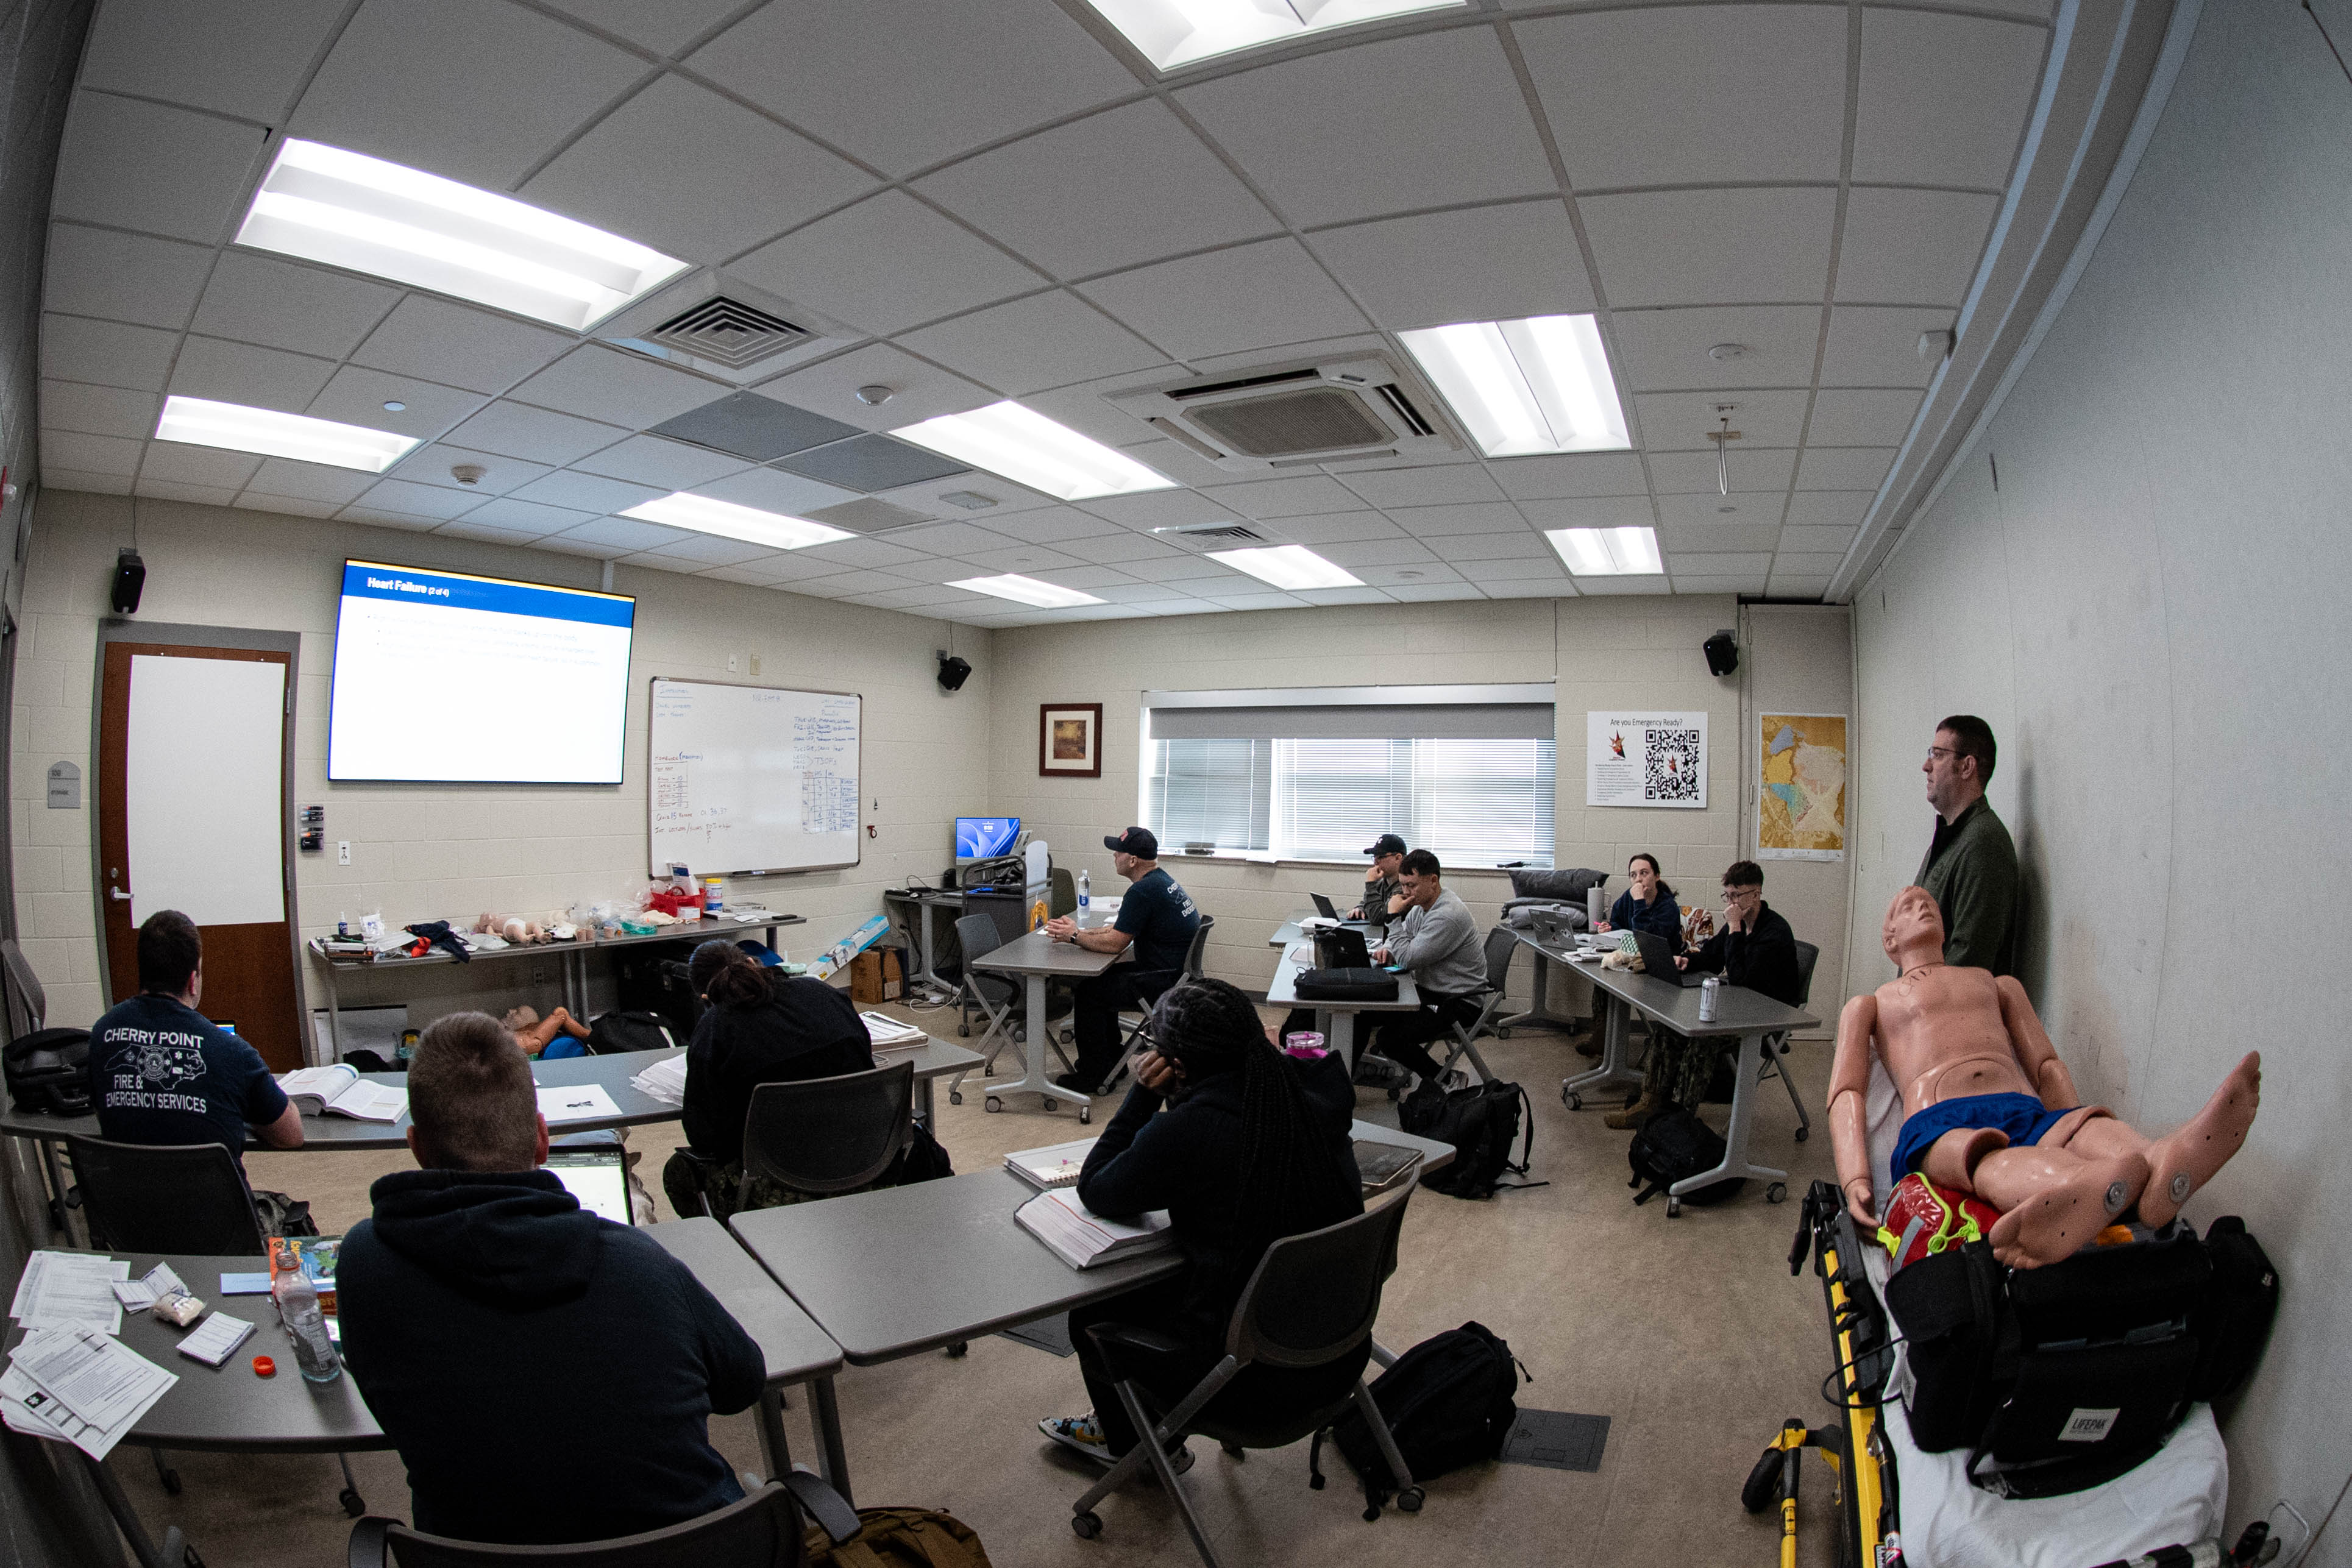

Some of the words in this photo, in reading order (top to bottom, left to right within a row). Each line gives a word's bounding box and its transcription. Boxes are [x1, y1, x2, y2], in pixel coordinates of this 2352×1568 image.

[368, 577, 394, 590] Heart
[394, 580, 427, 594] Failure
[428, 587, 435, 595] (2
[442, 589, 450, 598] 4)
[1632, 718, 1662, 728] Emergency
[1663, 718, 1683, 727] Ready?
[104, 1027, 156, 1045] CHERRY
[158, 1032, 204, 1049] POINT
[114, 1074, 134, 1089] FIRE
[135, 1074, 144, 1090] &
[106, 1091, 156, 1108] EMERGENCY
[157, 1093, 207, 1113] SERVICES
[2072, 1418, 2108, 1430] LIFEPAK
